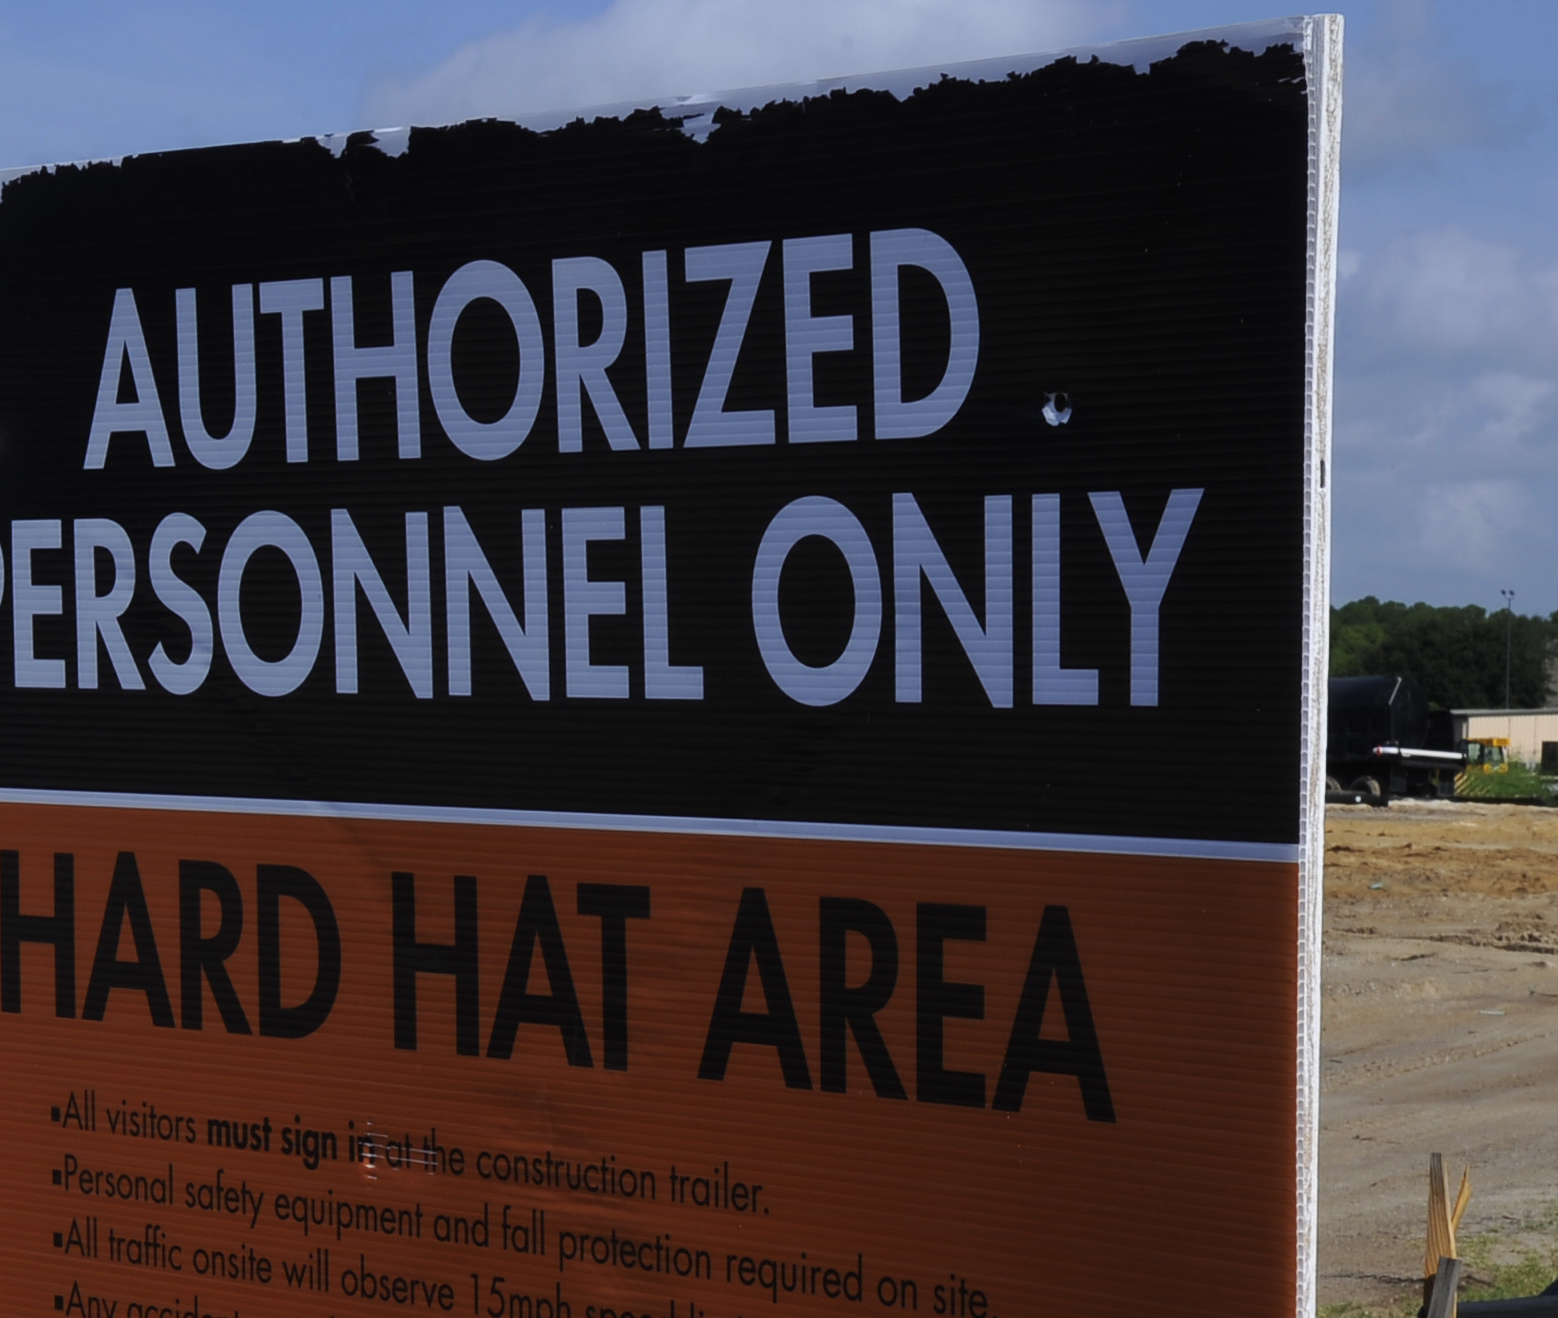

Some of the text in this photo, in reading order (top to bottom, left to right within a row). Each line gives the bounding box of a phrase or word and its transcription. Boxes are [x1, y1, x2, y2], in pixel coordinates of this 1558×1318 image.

[83, 227, 980, 471] AUTHORIZED
[751, 488, 1205, 709] ONLY
[0, 850, 1116, 1123] HARD HAT AREA
[63, 1090, 769, 1214] All visitors must sign in at the construction trailer.
[65, 1154, 173, 1204] Personal
[186, 1169, 264, 1229] safety
[275, 1190, 423, 1240] equipment
[434, 1203, 489, 1247] and
[502, 1205, 545, 1255] fall
[559, 1229, 711, 1279] protection
[727, 1253, 863, 1303] required
[877, 1277, 917, 1309] on
[65, 1217, 97, 1257] All
[109, 1224, 182, 1271] traffic
[193, 1244, 272, 1284] onsite
[283, 1248, 329, 1292] will
[341, 1254, 454, 1311] observe
